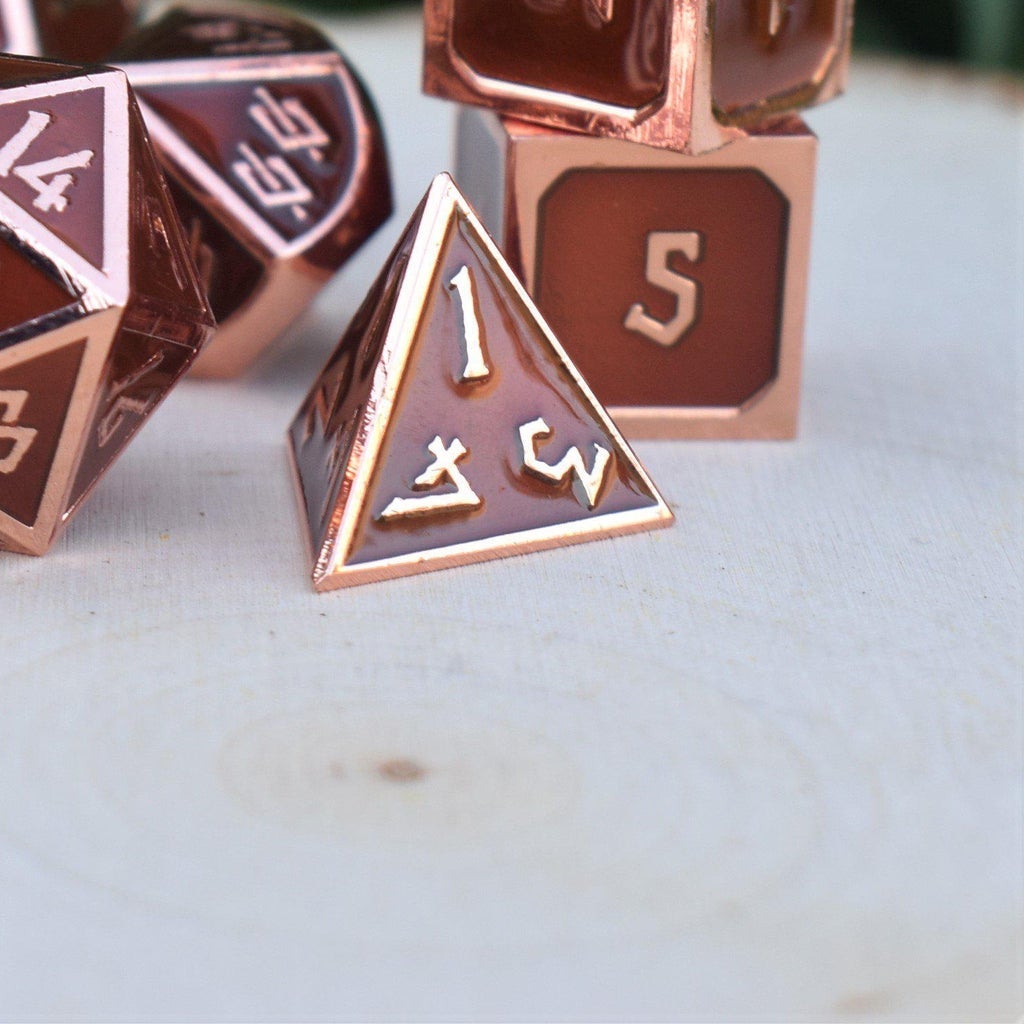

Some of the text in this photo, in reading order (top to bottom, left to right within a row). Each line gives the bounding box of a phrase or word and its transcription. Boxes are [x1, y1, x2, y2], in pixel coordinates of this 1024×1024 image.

[448, 265, 489, 378] 1
[623, 230, 702, 347] 5
[380, 435, 480, 522] 4
[518, 417, 614, 509] 3
